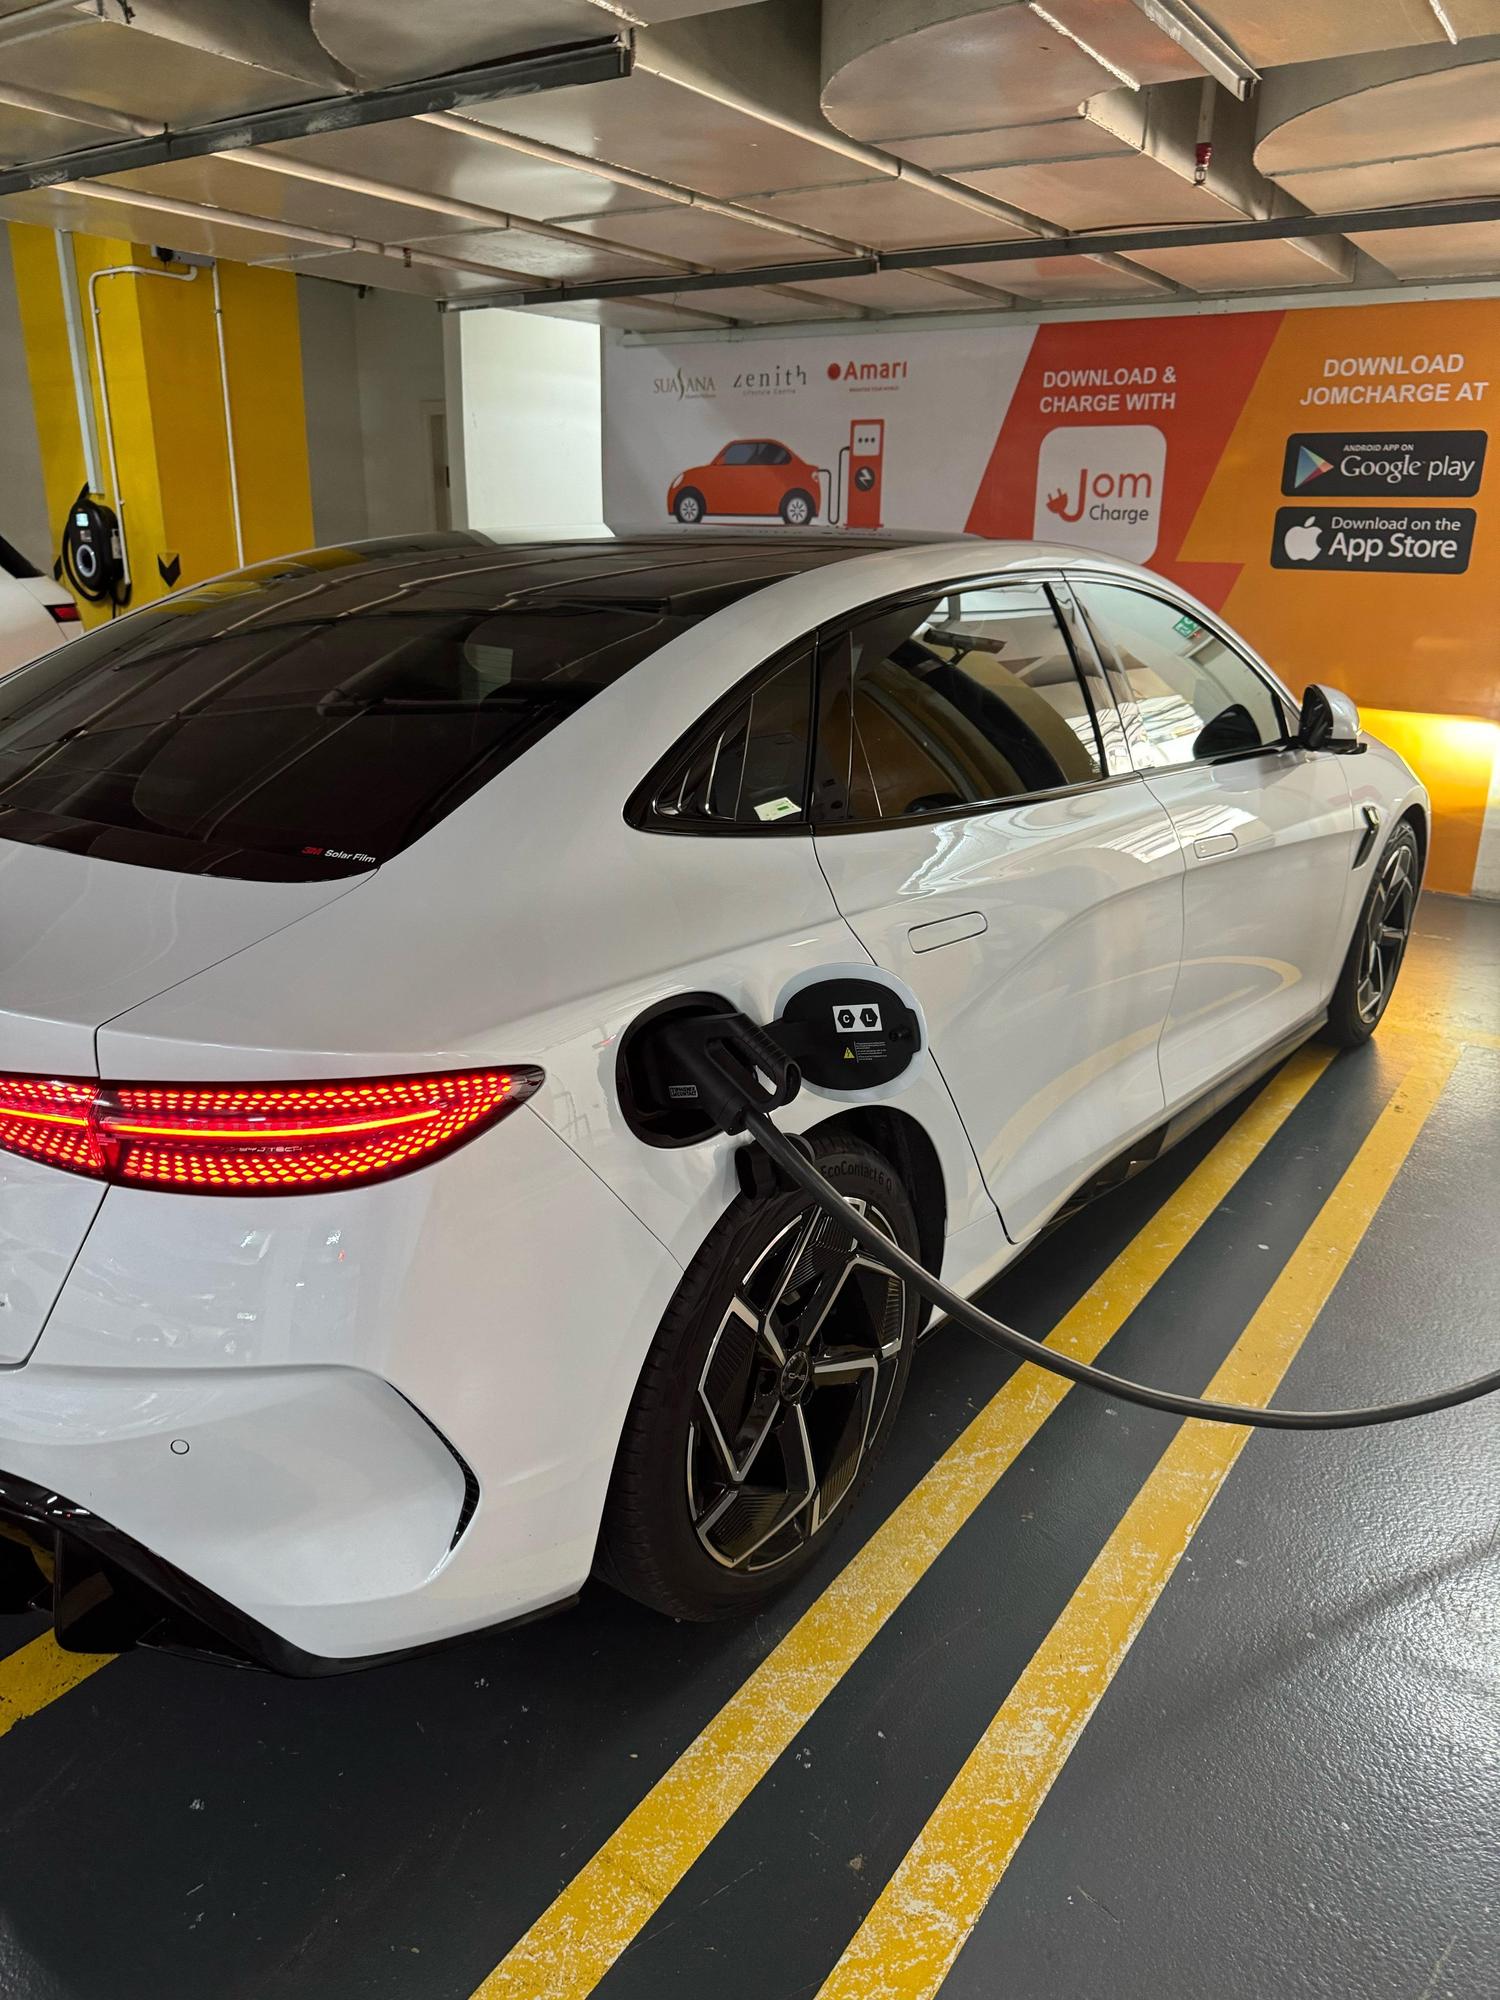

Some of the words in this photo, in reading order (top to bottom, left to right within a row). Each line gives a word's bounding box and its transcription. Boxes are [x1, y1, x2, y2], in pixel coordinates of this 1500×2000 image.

[733, 364, 807, 388] zenith
[843, 361, 908, 381] Amari
[1323, 354, 1464, 377] DOWNLOAD
[1043, 367, 1157, 388] DOWNLOAD
[1162, 366, 1177, 384] &
[1039, 394, 1121, 413] CHARGE
[1125, 392, 1176, 411] WITH
[1300, 383, 1450, 406] JOMCHARGE
[1456, 382, 1489, 401] AT
[1343, 444, 1381, 452] ANDROID
[1401, 443, 1414, 451] ON
[1340, 454, 1422, 484] Google
[1427, 455, 1476, 482] play
[1089, 504, 1149, 525] Charge
[1331, 516, 1407, 531] Download
[1411, 519, 1431, 531] on
[1435, 517, 1461, 531] the
[1328, 532, 1383, 562] App
[1387, 533, 1458, 559] Store
[324, 849, 353, 860] Solar
[353, 853, 376, 863] Film
[842, 1014, 850, 1024] C
[865, 1013, 873, 1022] L
[820, 1160, 877, 1180] EcoContact
[879, 1171, 885, 1185] 6
